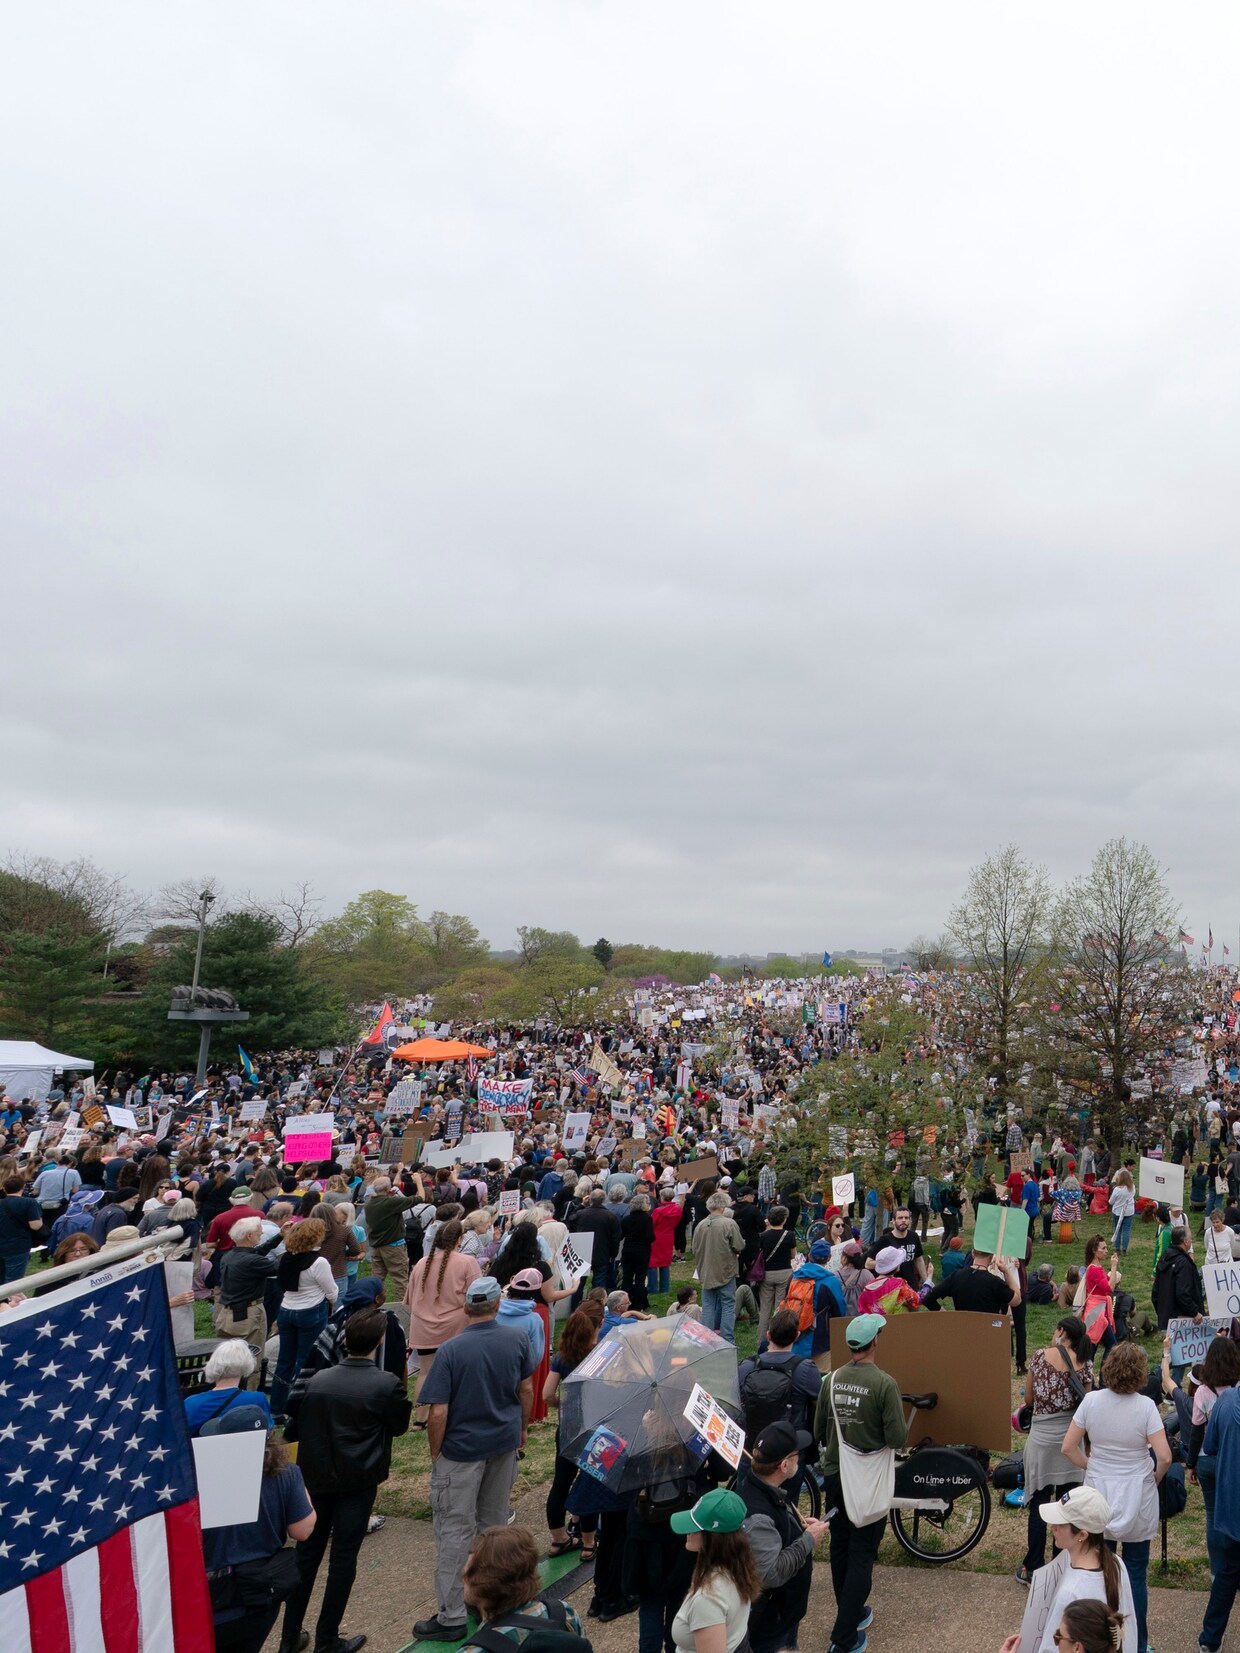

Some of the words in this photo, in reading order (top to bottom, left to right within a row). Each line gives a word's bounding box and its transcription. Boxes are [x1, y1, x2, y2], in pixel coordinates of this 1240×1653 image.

[482, 1079, 525, 1093] MAKE
[411, 1090, 420, 1098] MY
[480, 1088, 530, 1107] DEMOCRACY
[479, 1099, 501, 1114] GREAT
[505, 1103, 527, 1114] AGAIN
[566, 1236, 584, 1268] HANDS
[906, 1244, 915, 1252] UP
[90, 1272, 113, 1286] Annin
[1173, 1326, 1211, 1344] APRIL
[577, 1459, 605, 1482] LOSER
[913, 1475, 927, 1484] On
[928, 1474, 945, 1484] Lime
[952, 1475, 972, 1485] Uber
